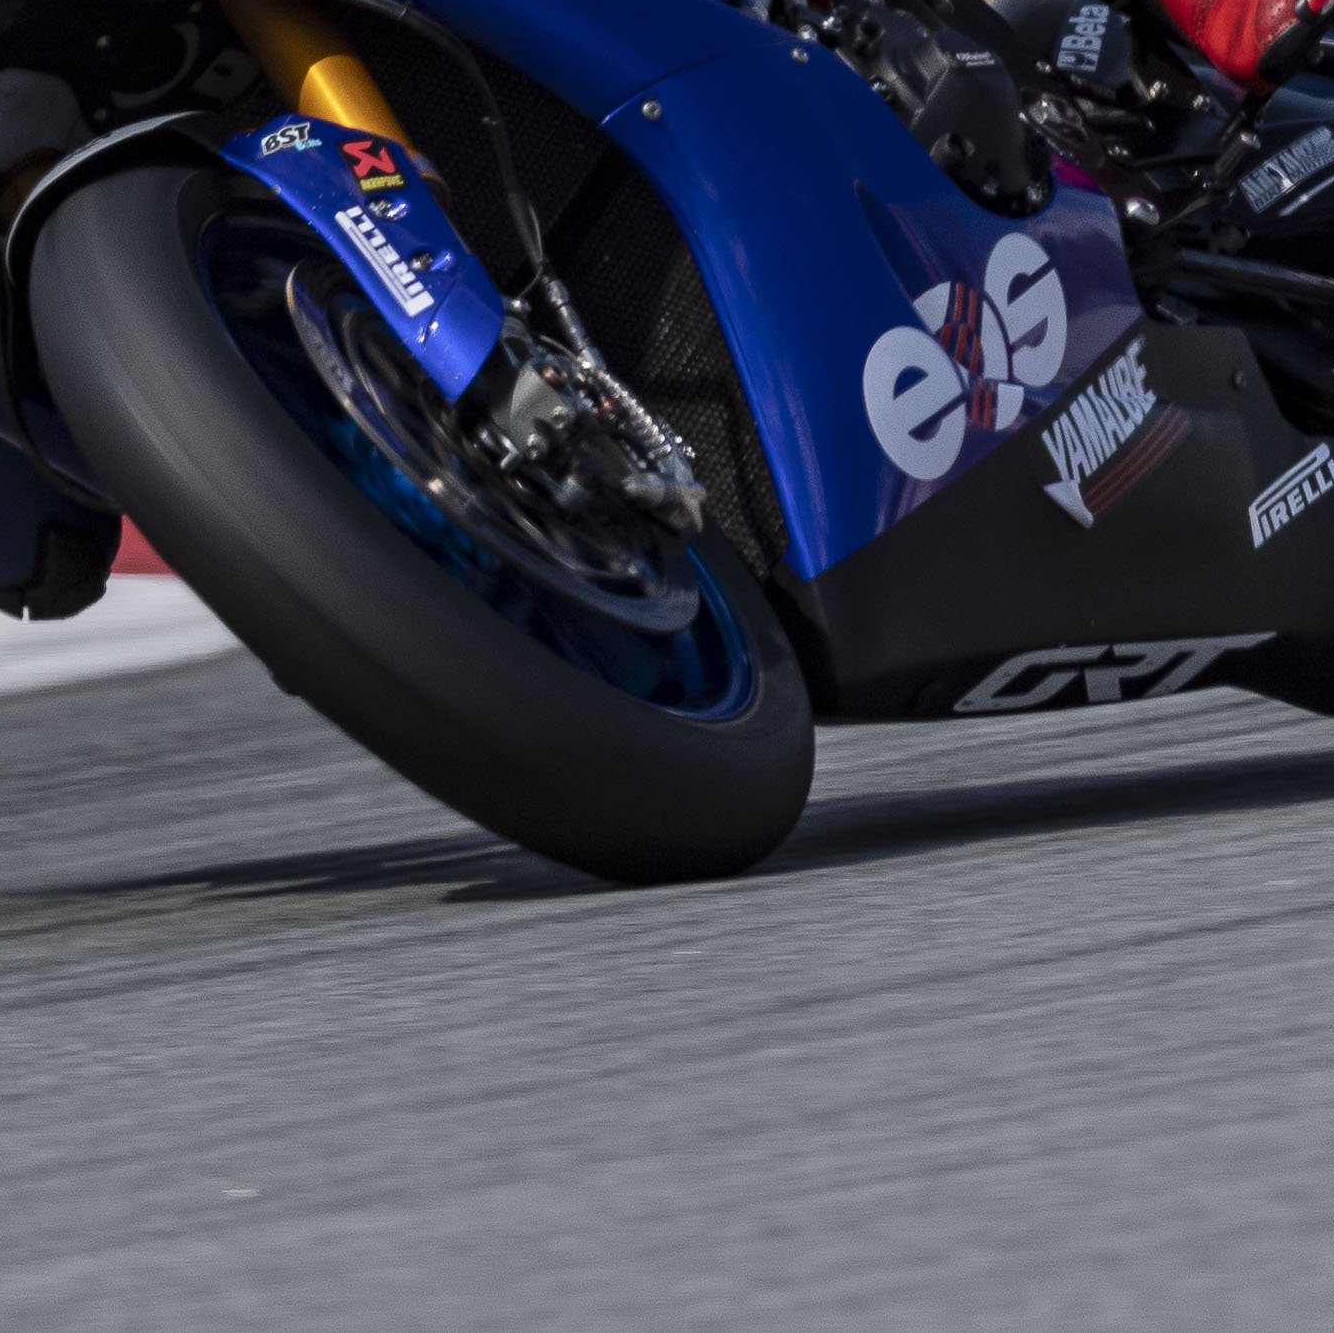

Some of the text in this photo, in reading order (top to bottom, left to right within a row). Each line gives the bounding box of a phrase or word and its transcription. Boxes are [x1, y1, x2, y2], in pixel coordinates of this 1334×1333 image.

[1061, 4, 1110, 52] Beta
[261, 122, 310, 155] BST
[334, 205, 435, 317] PIRELLI
[1041, 333, 1157, 529] YAMALUBE
